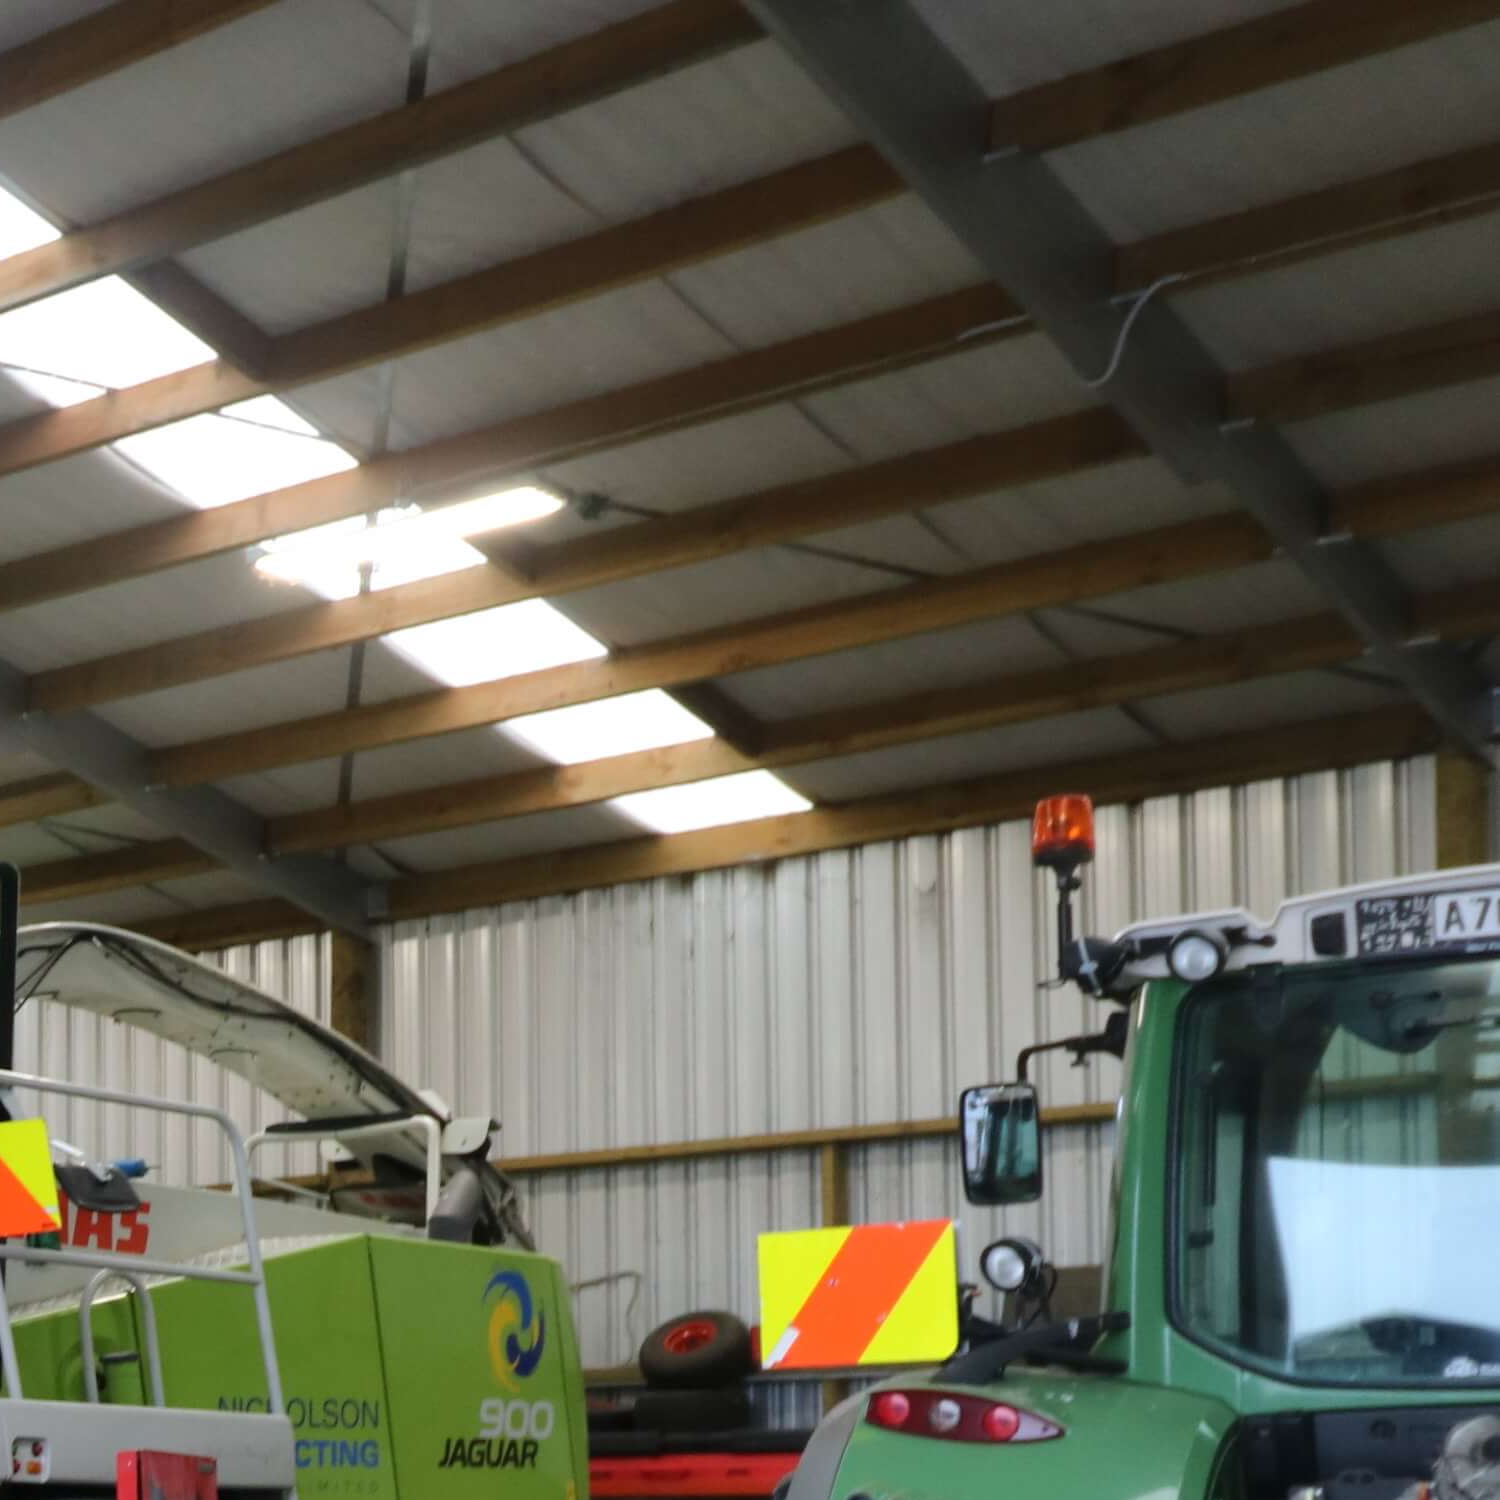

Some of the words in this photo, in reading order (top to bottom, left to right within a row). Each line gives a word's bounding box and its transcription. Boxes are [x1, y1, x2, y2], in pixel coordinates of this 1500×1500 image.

[1443, 896, 1500, 934] A7
[479, 1398, 553, 1440] 900
[438, 1437, 539, 1468] JAGUAR
